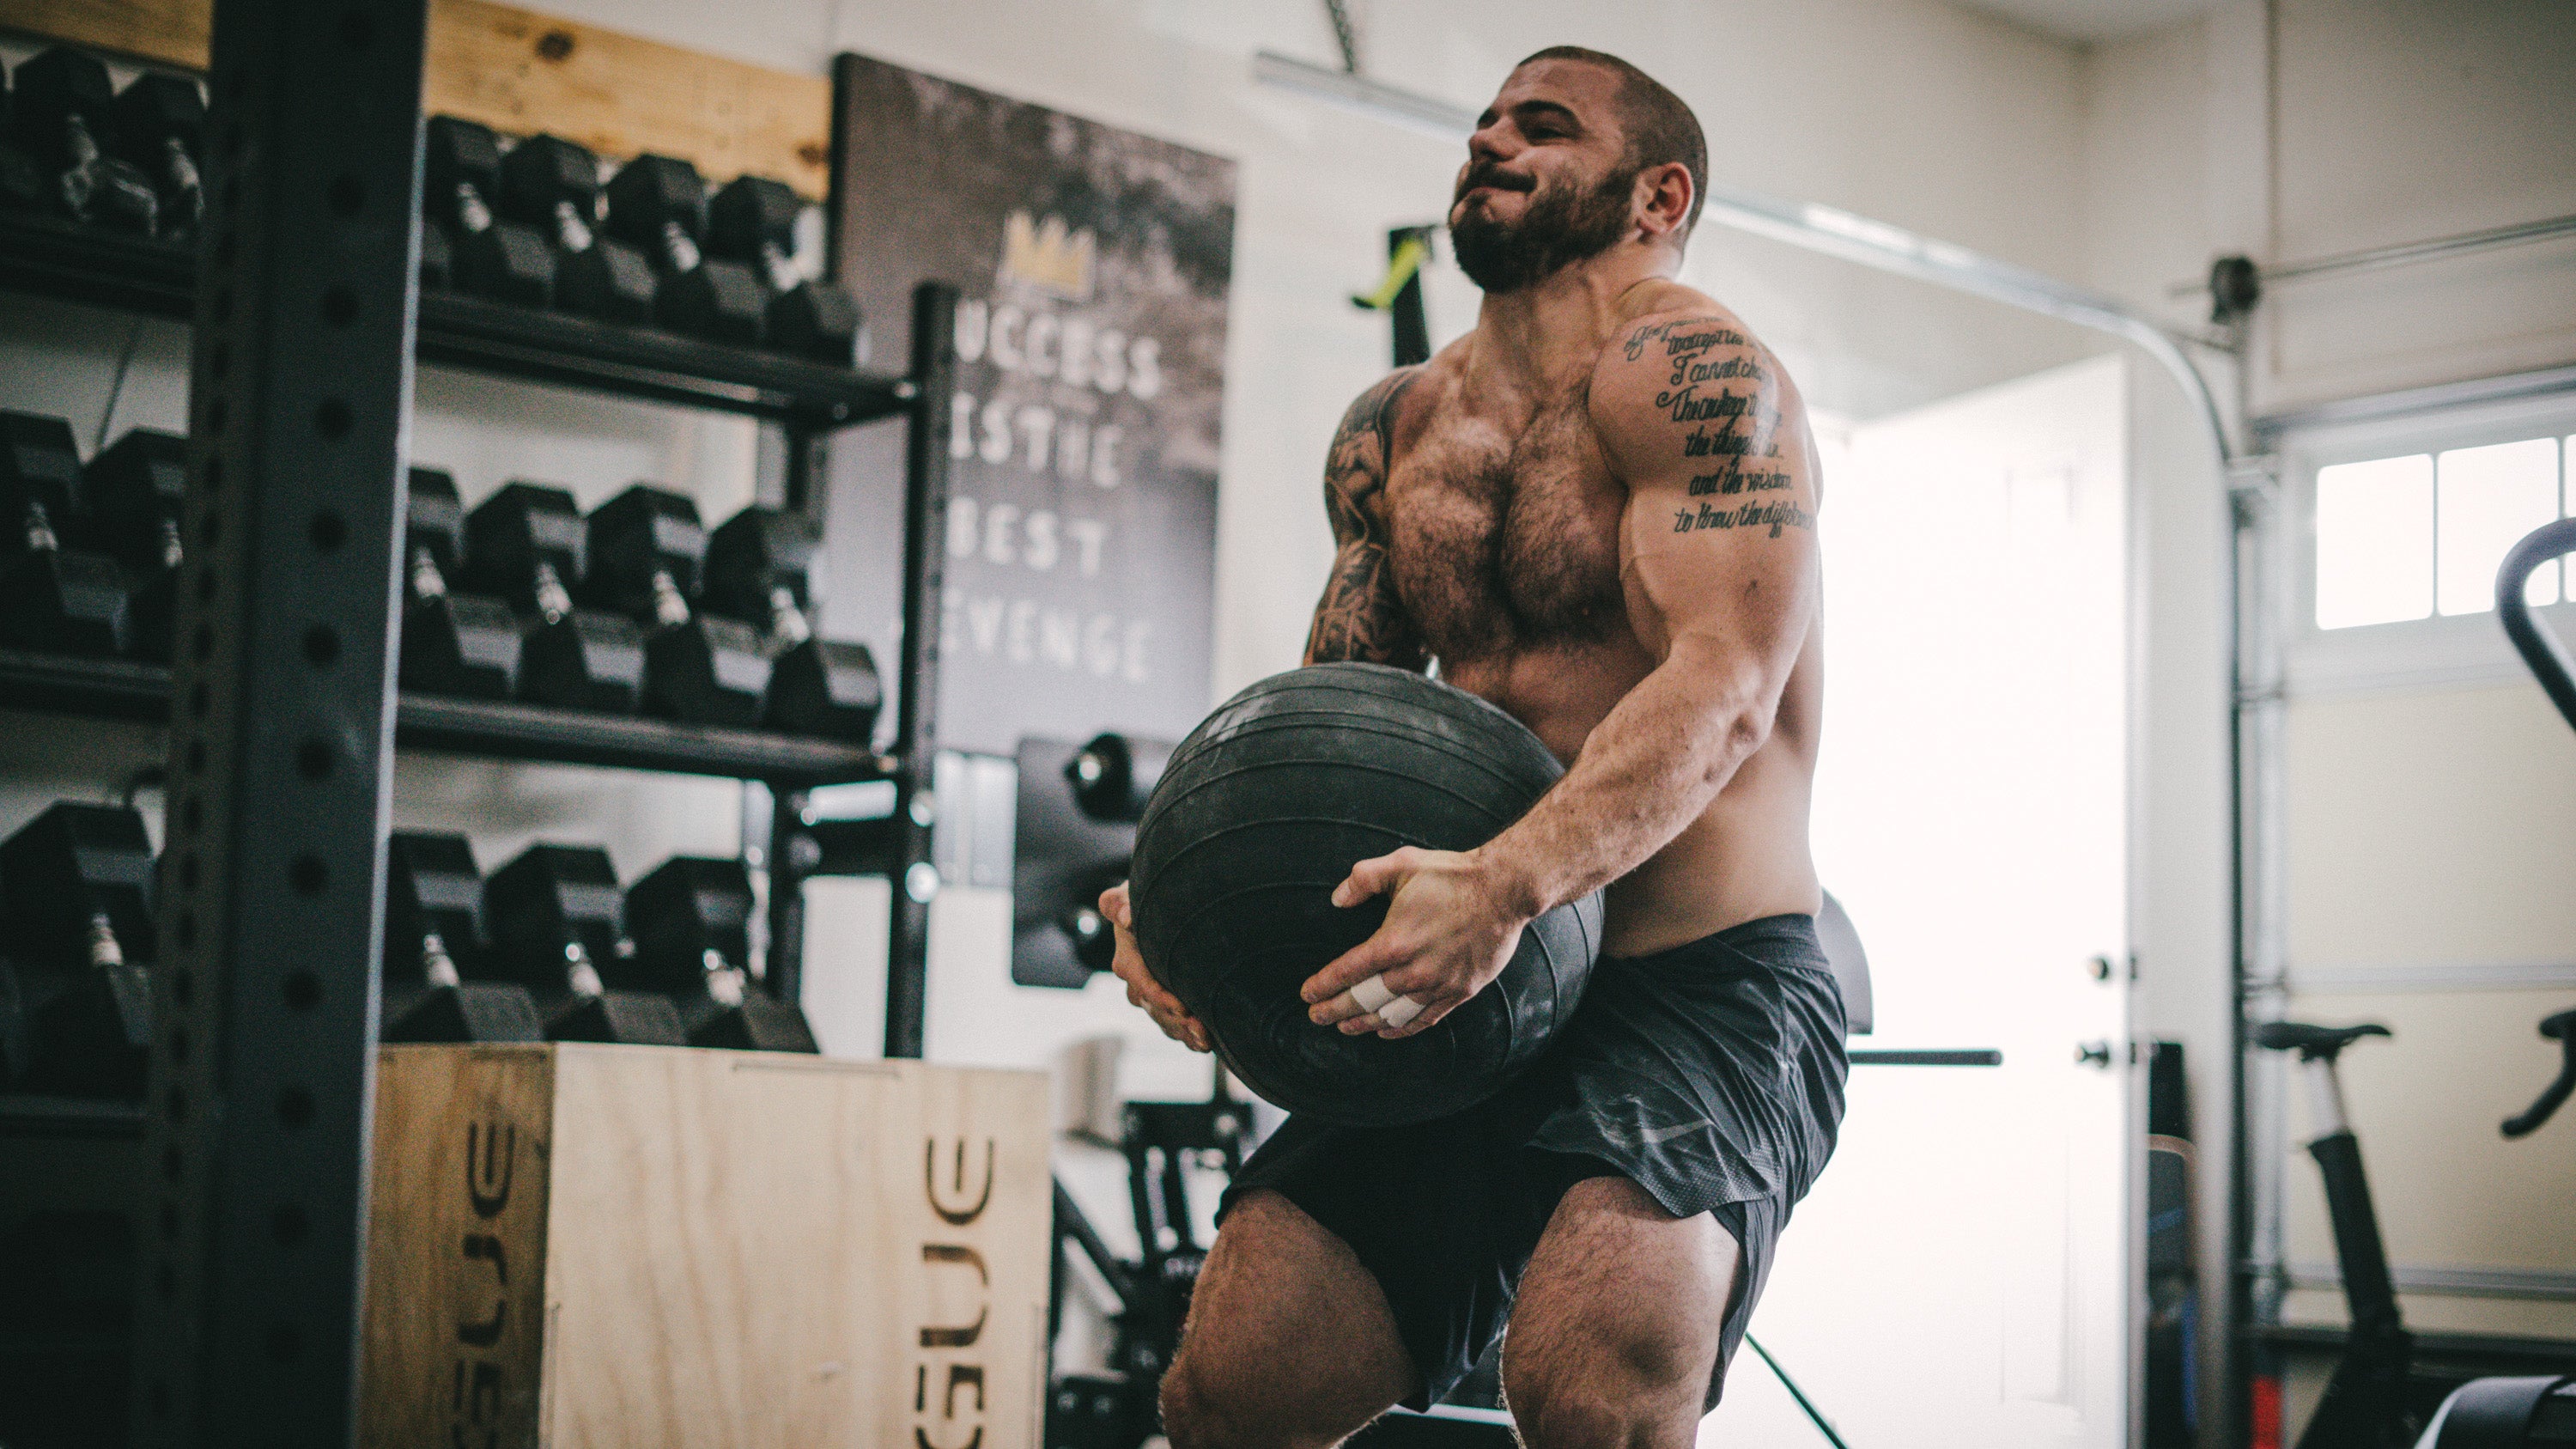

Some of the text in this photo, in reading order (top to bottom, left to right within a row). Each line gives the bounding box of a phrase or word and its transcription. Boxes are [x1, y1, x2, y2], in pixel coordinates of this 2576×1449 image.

[954, 299, 1161, 399] UCCESS
[1674, 508, 1695, 533] to
[1739, 500, 1760, 527] the
[1689, 466, 1722, 496] and
[947, 495, 1105, 580] BEST
[940, 587, 1152, 685] EVENGE
